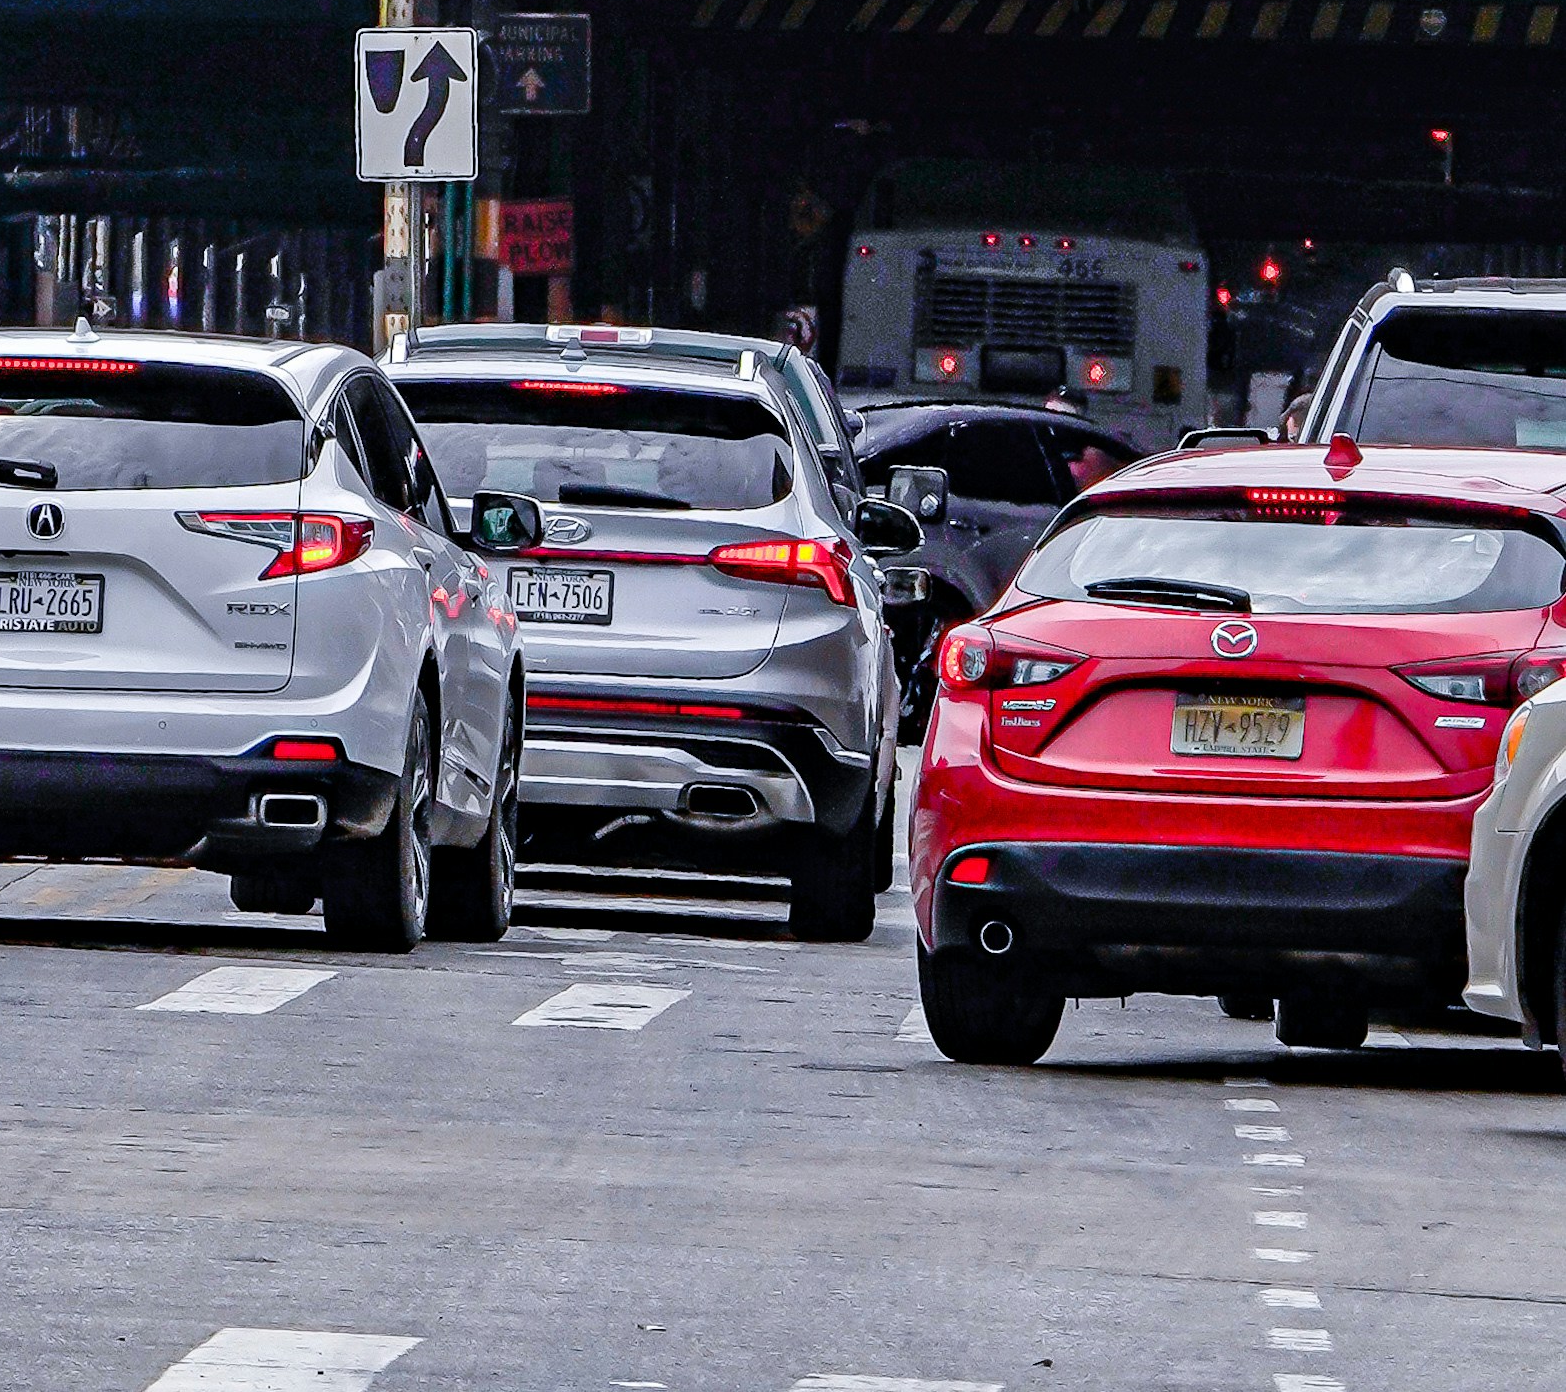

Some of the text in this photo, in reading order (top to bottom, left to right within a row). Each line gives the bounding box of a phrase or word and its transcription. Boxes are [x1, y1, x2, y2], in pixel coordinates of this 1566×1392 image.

[18, 577, 76, 588] NEW YORK
[226, 601, 291, 617] RDX
[57, 620, 98, 632] AUTO
[1207, 694, 1274, 708] NEW YORK
